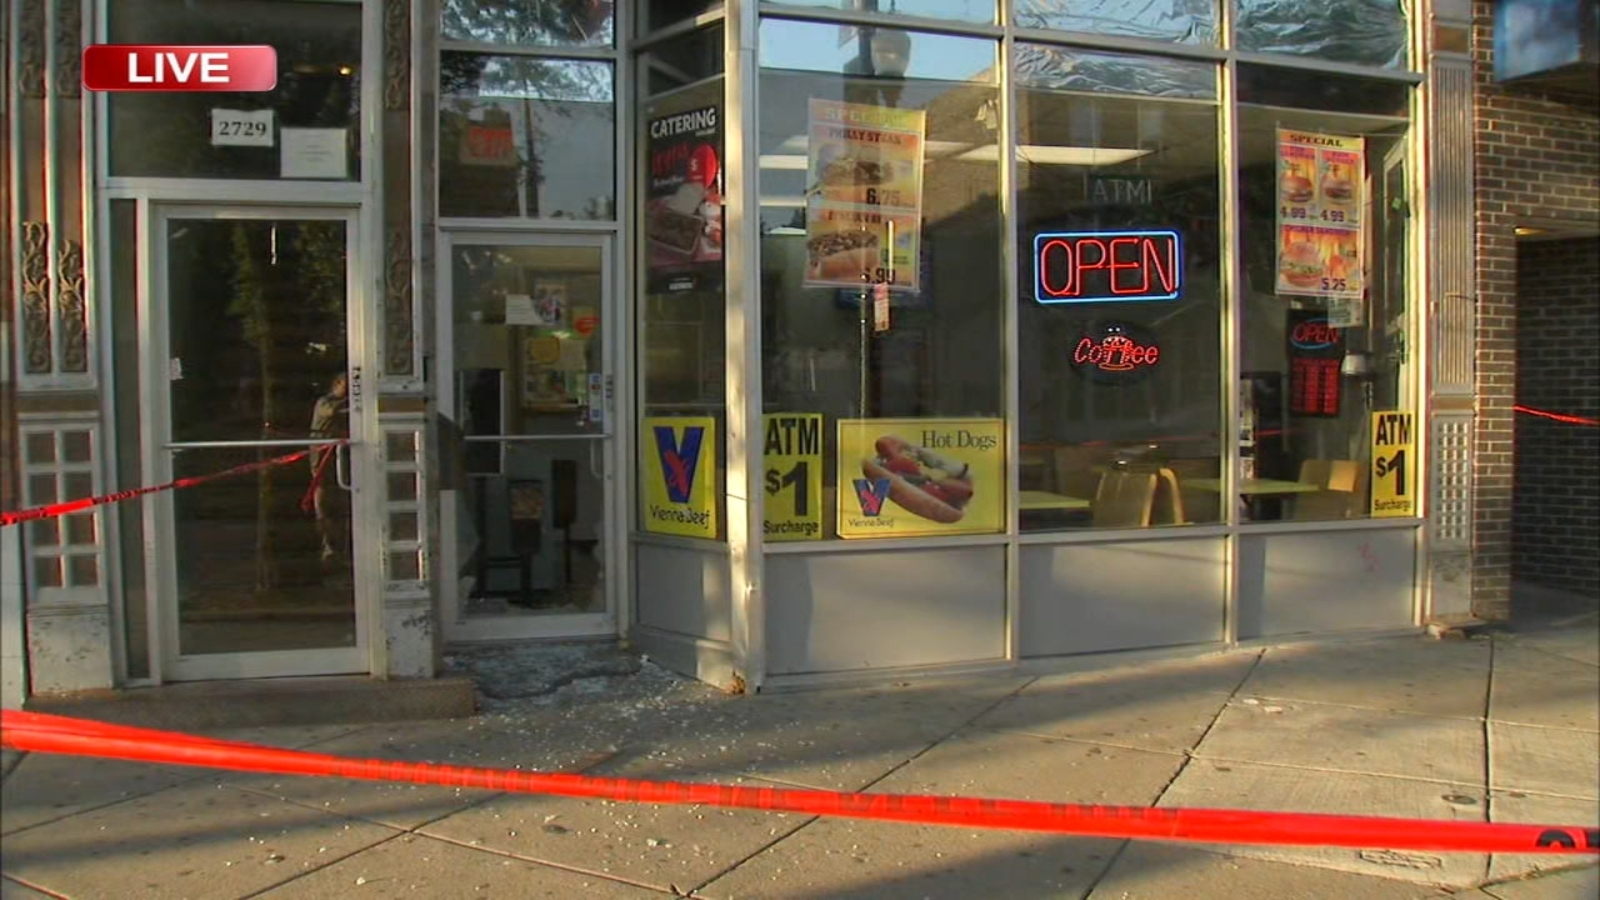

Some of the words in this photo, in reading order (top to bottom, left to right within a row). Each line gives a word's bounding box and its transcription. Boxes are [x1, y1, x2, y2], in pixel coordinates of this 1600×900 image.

[218, 120, 267, 137] 2729
[651, 107, 716, 138] CATERING
[1289, 134, 1344, 147] SPECIAL
[1093, 179, 1147, 205] ATM
[1040, 237, 1174, 296] OPEN
[1292, 322, 1340, 344] OPEN
[1074, 337, 1159, 366] Coffee
[763, 417, 819, 455] ATM
[921, 429, 952, 448] Hot
[957, 429, 998, 451] Dogs
[1375, 413, 1412, 446] ATM
[1375, 450, 1405, 496] $1
[765, 461, 807, 516] $1
[650, 503, 685, 523] Vienna
[763, 520, 819, 536] Surcharge
